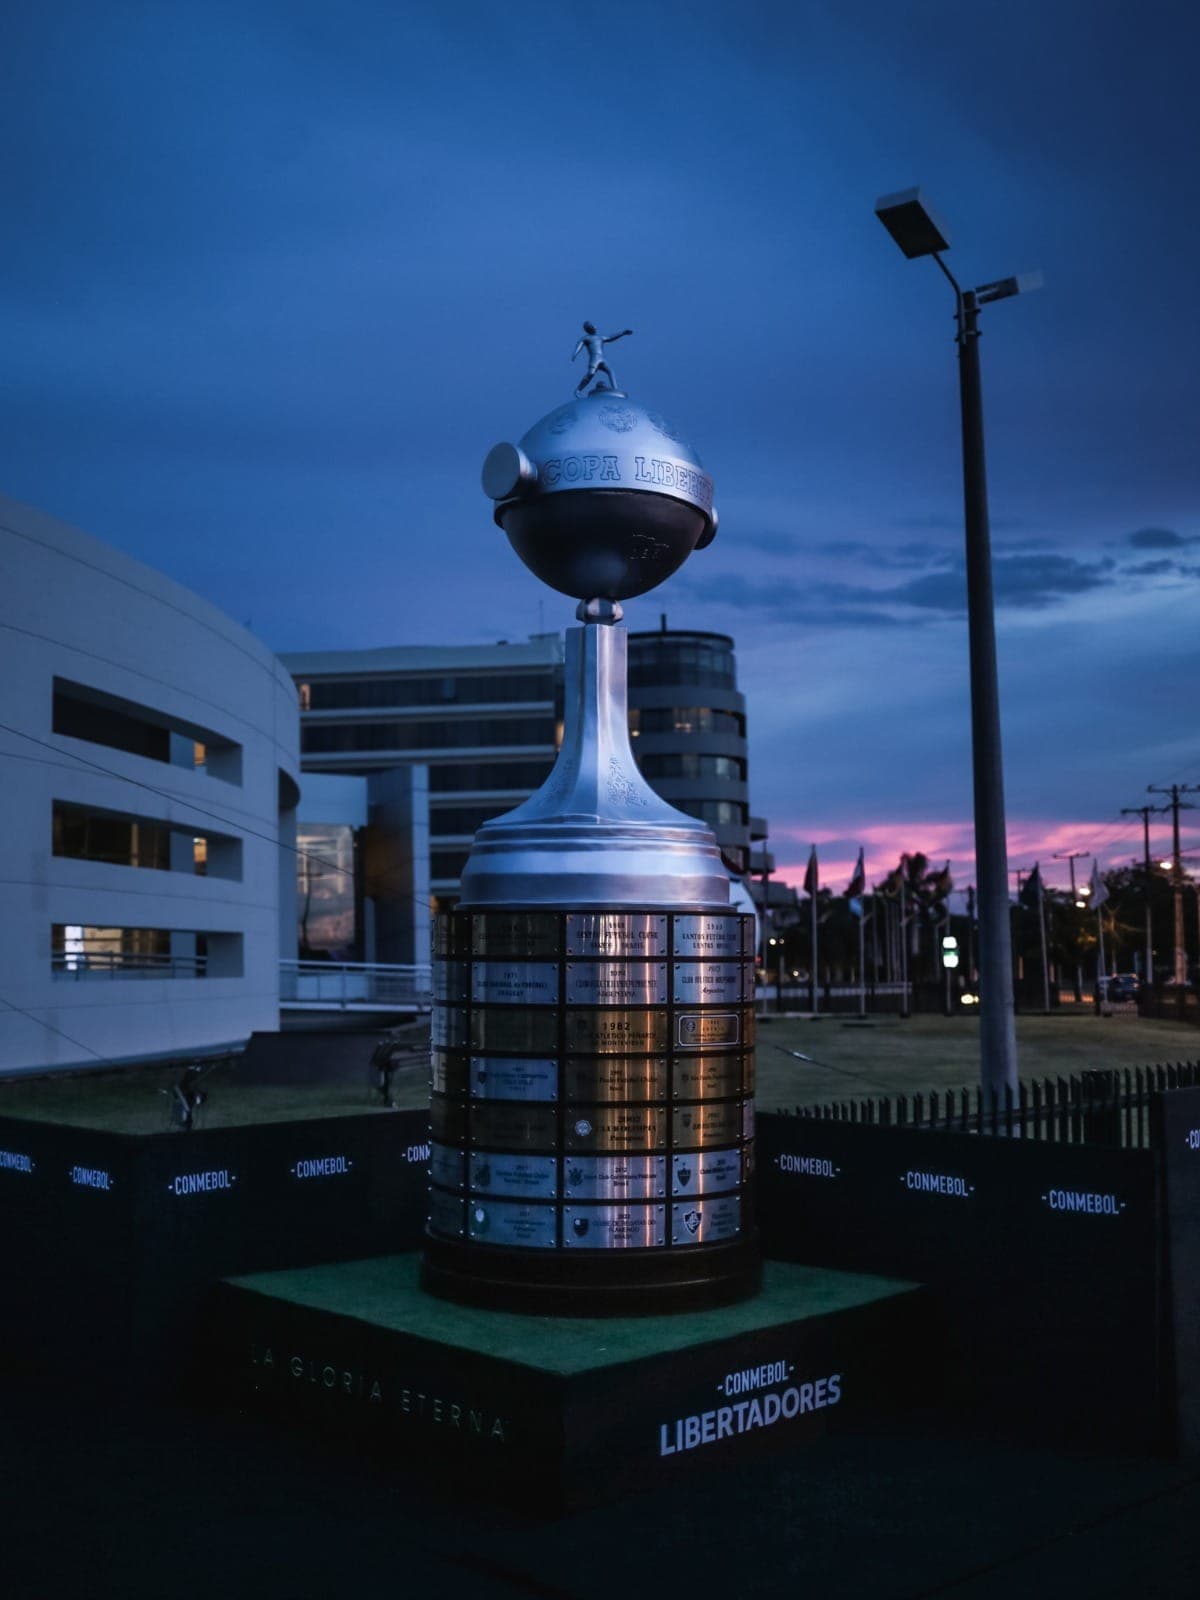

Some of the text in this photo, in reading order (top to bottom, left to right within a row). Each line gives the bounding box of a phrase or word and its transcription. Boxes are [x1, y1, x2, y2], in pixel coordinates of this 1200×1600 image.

[543, 455, 621, 486] COPA
[602, 1022, 631, 1032] 1982
[289, 1355, 383, 1405] GLORIA
[402, 1387, 505, 1443] ETERNA
[659, 1374, 842, 1457] LIBERTADORES
